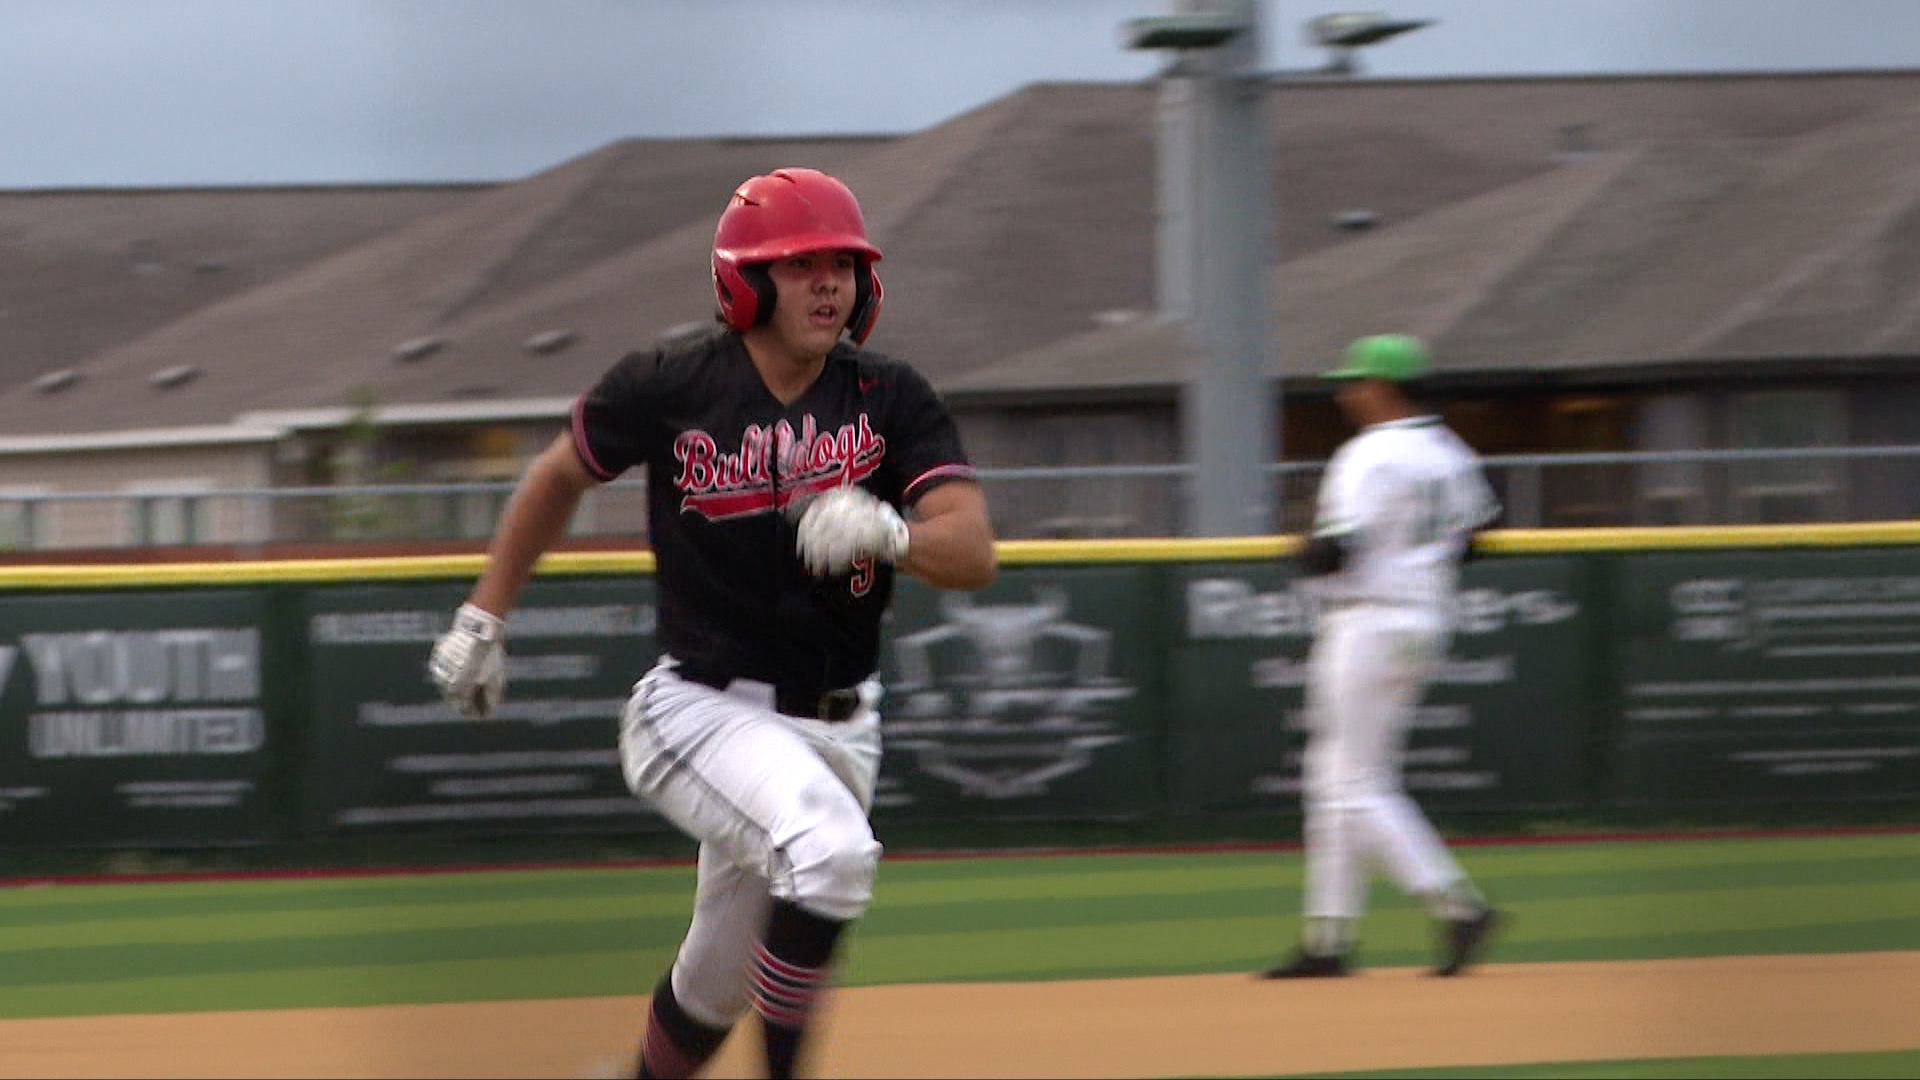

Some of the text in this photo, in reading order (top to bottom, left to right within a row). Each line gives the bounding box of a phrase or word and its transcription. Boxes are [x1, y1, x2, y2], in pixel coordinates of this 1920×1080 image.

[673, 412, 886, 493] Bulldogs
[20, 627, 260, 704] YOUTH
[28, 708, 264, 758] UNLIMITED
